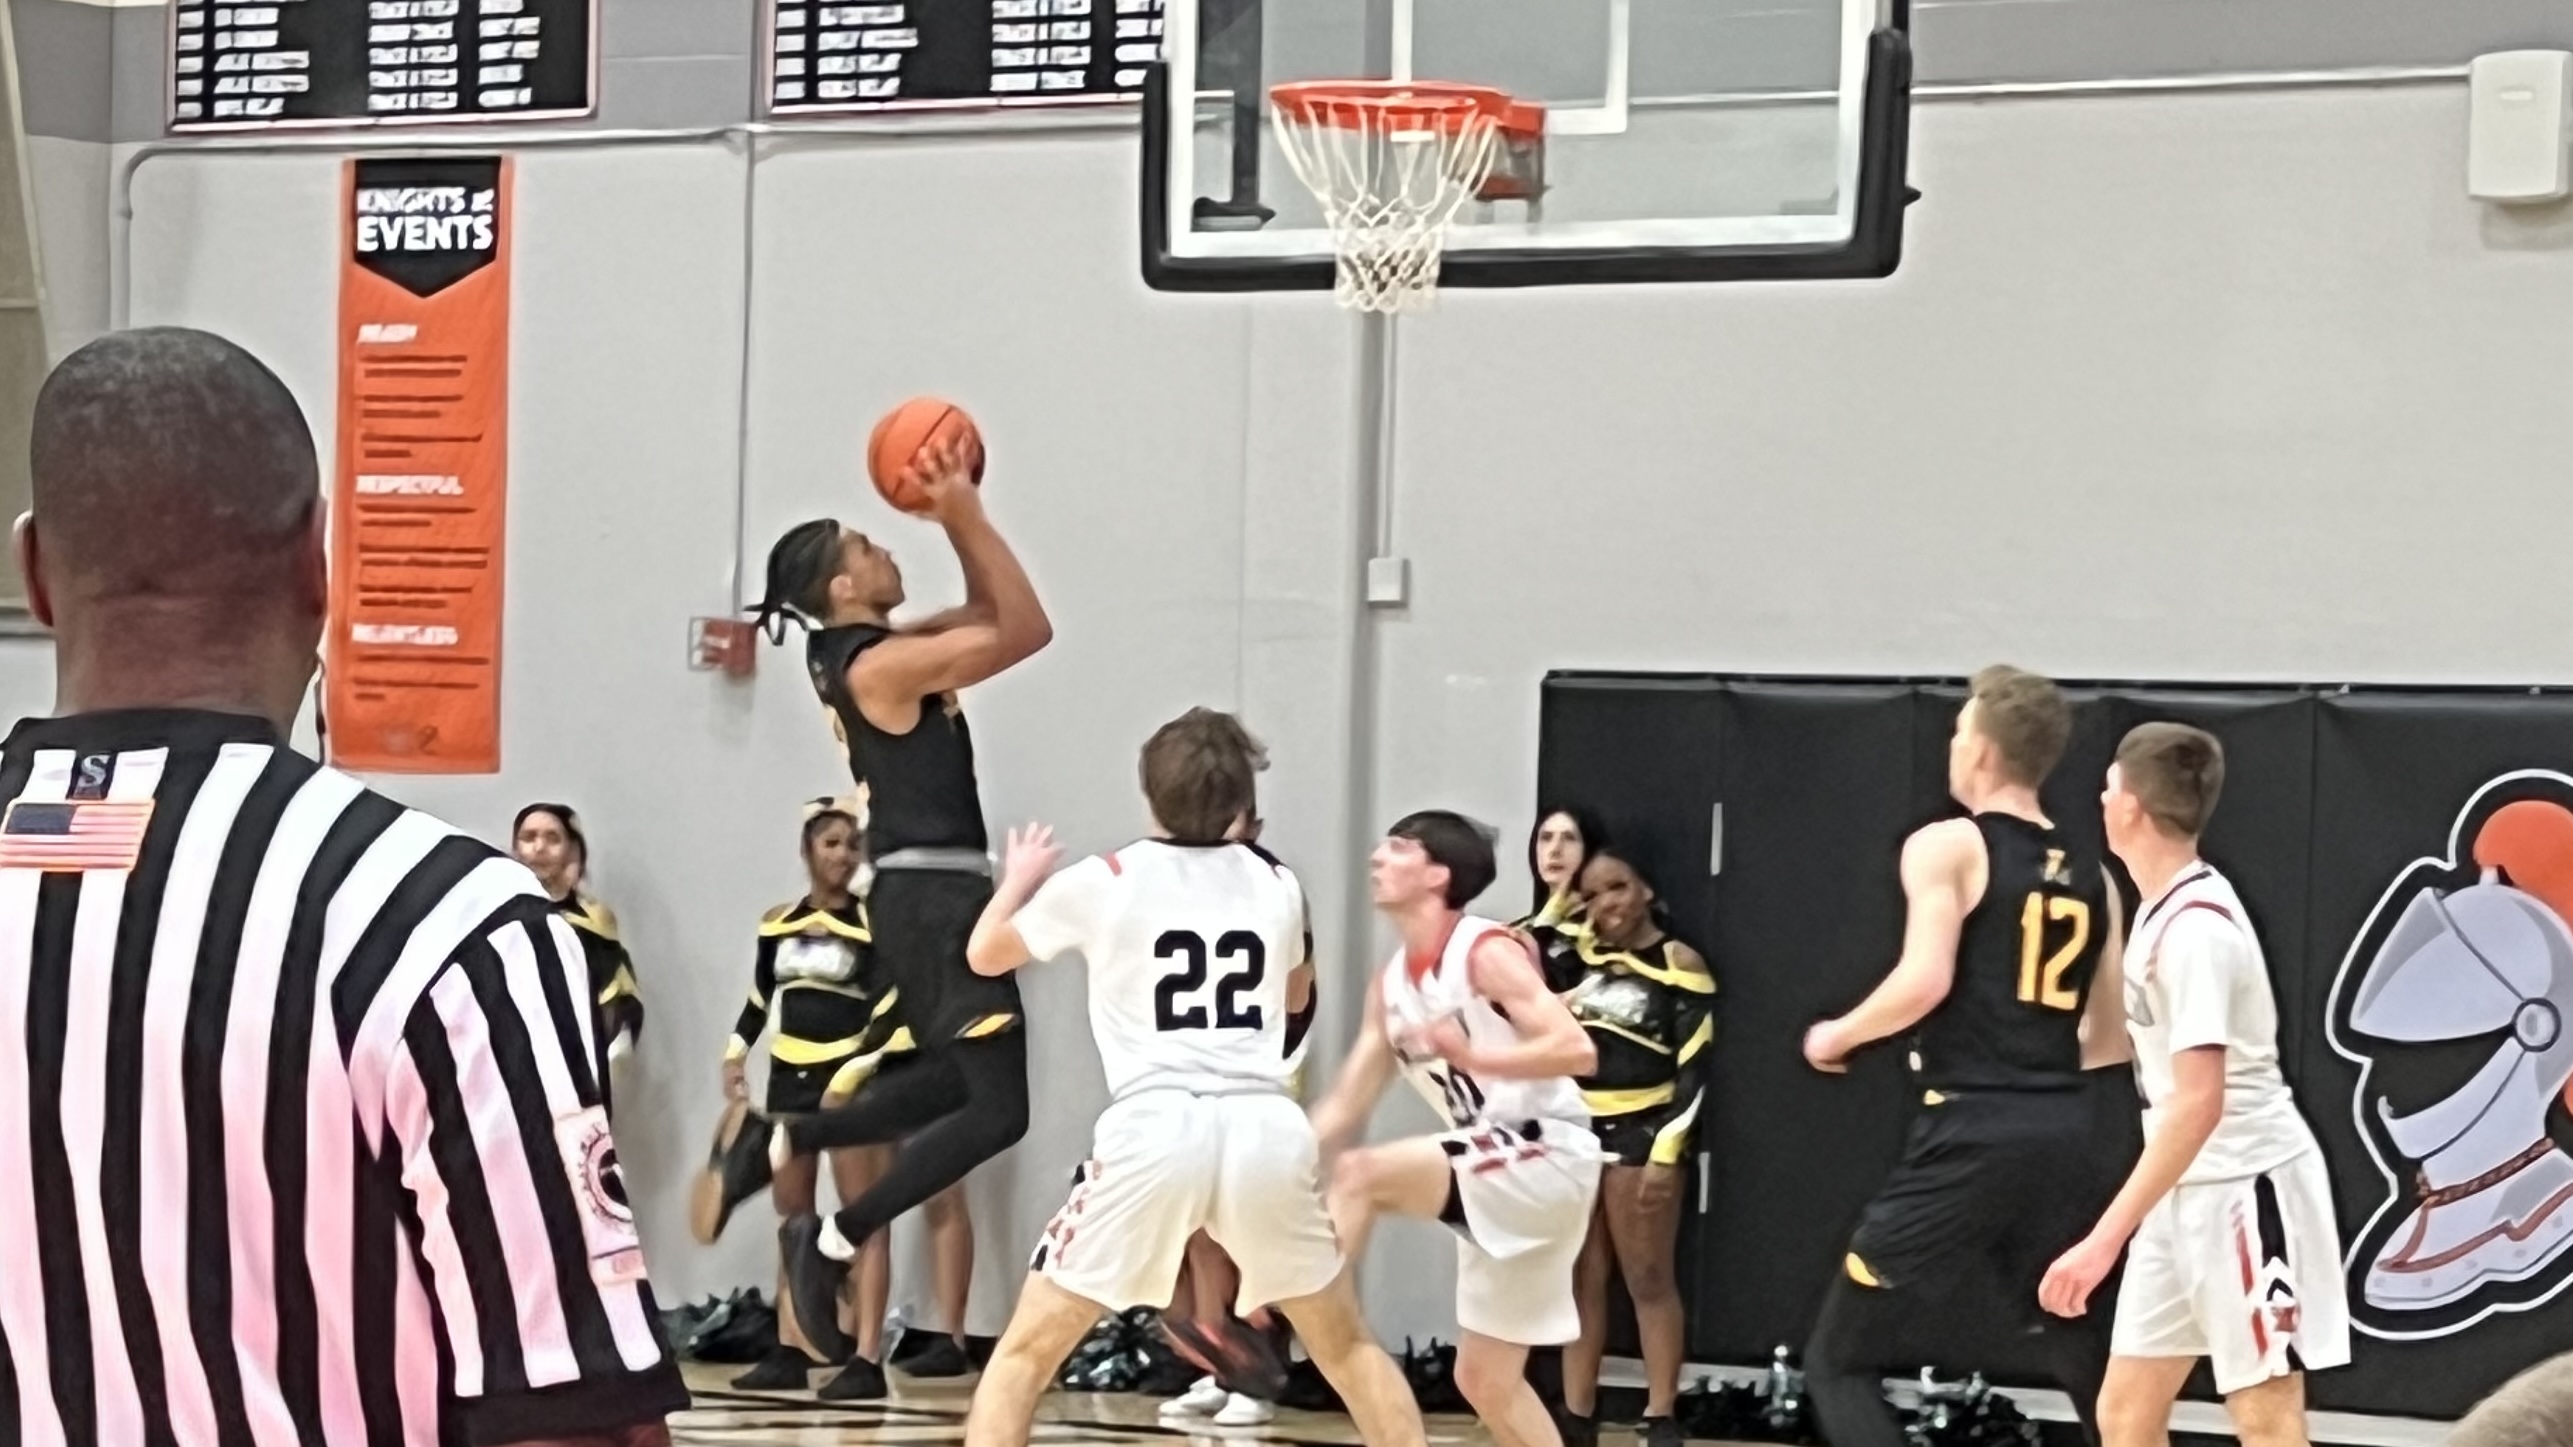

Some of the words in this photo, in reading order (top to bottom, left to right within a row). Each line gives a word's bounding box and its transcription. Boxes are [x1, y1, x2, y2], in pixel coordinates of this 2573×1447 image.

[357, 214, 494, 252] EVENTS
[1154, 930, 1265, 1031] 22
[2016, 891, 2090, 1010] 12
